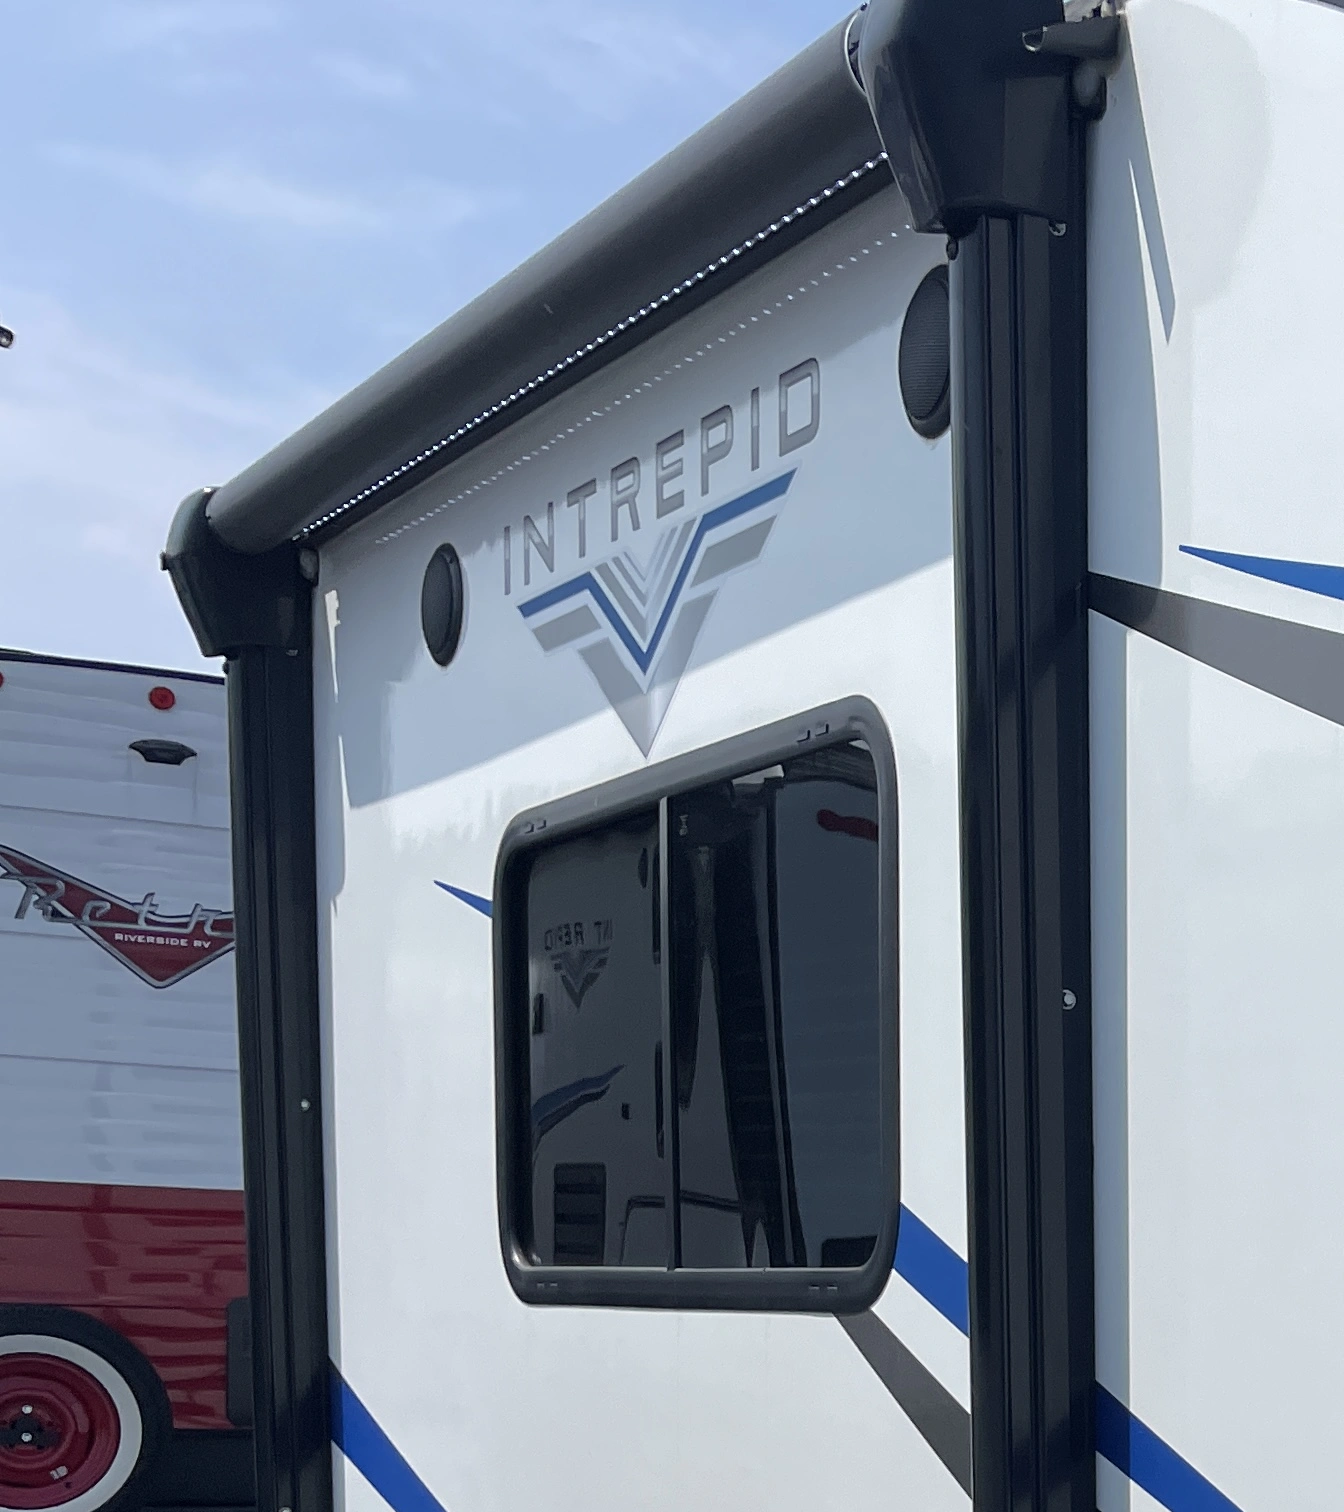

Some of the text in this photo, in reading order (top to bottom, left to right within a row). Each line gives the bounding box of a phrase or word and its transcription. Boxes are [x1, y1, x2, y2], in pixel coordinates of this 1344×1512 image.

[502, 357, 821, 596] INTREPID
[0, 874, 235, 938] Retr
[114, 932, 211, 949] RIVERSIDE RV
